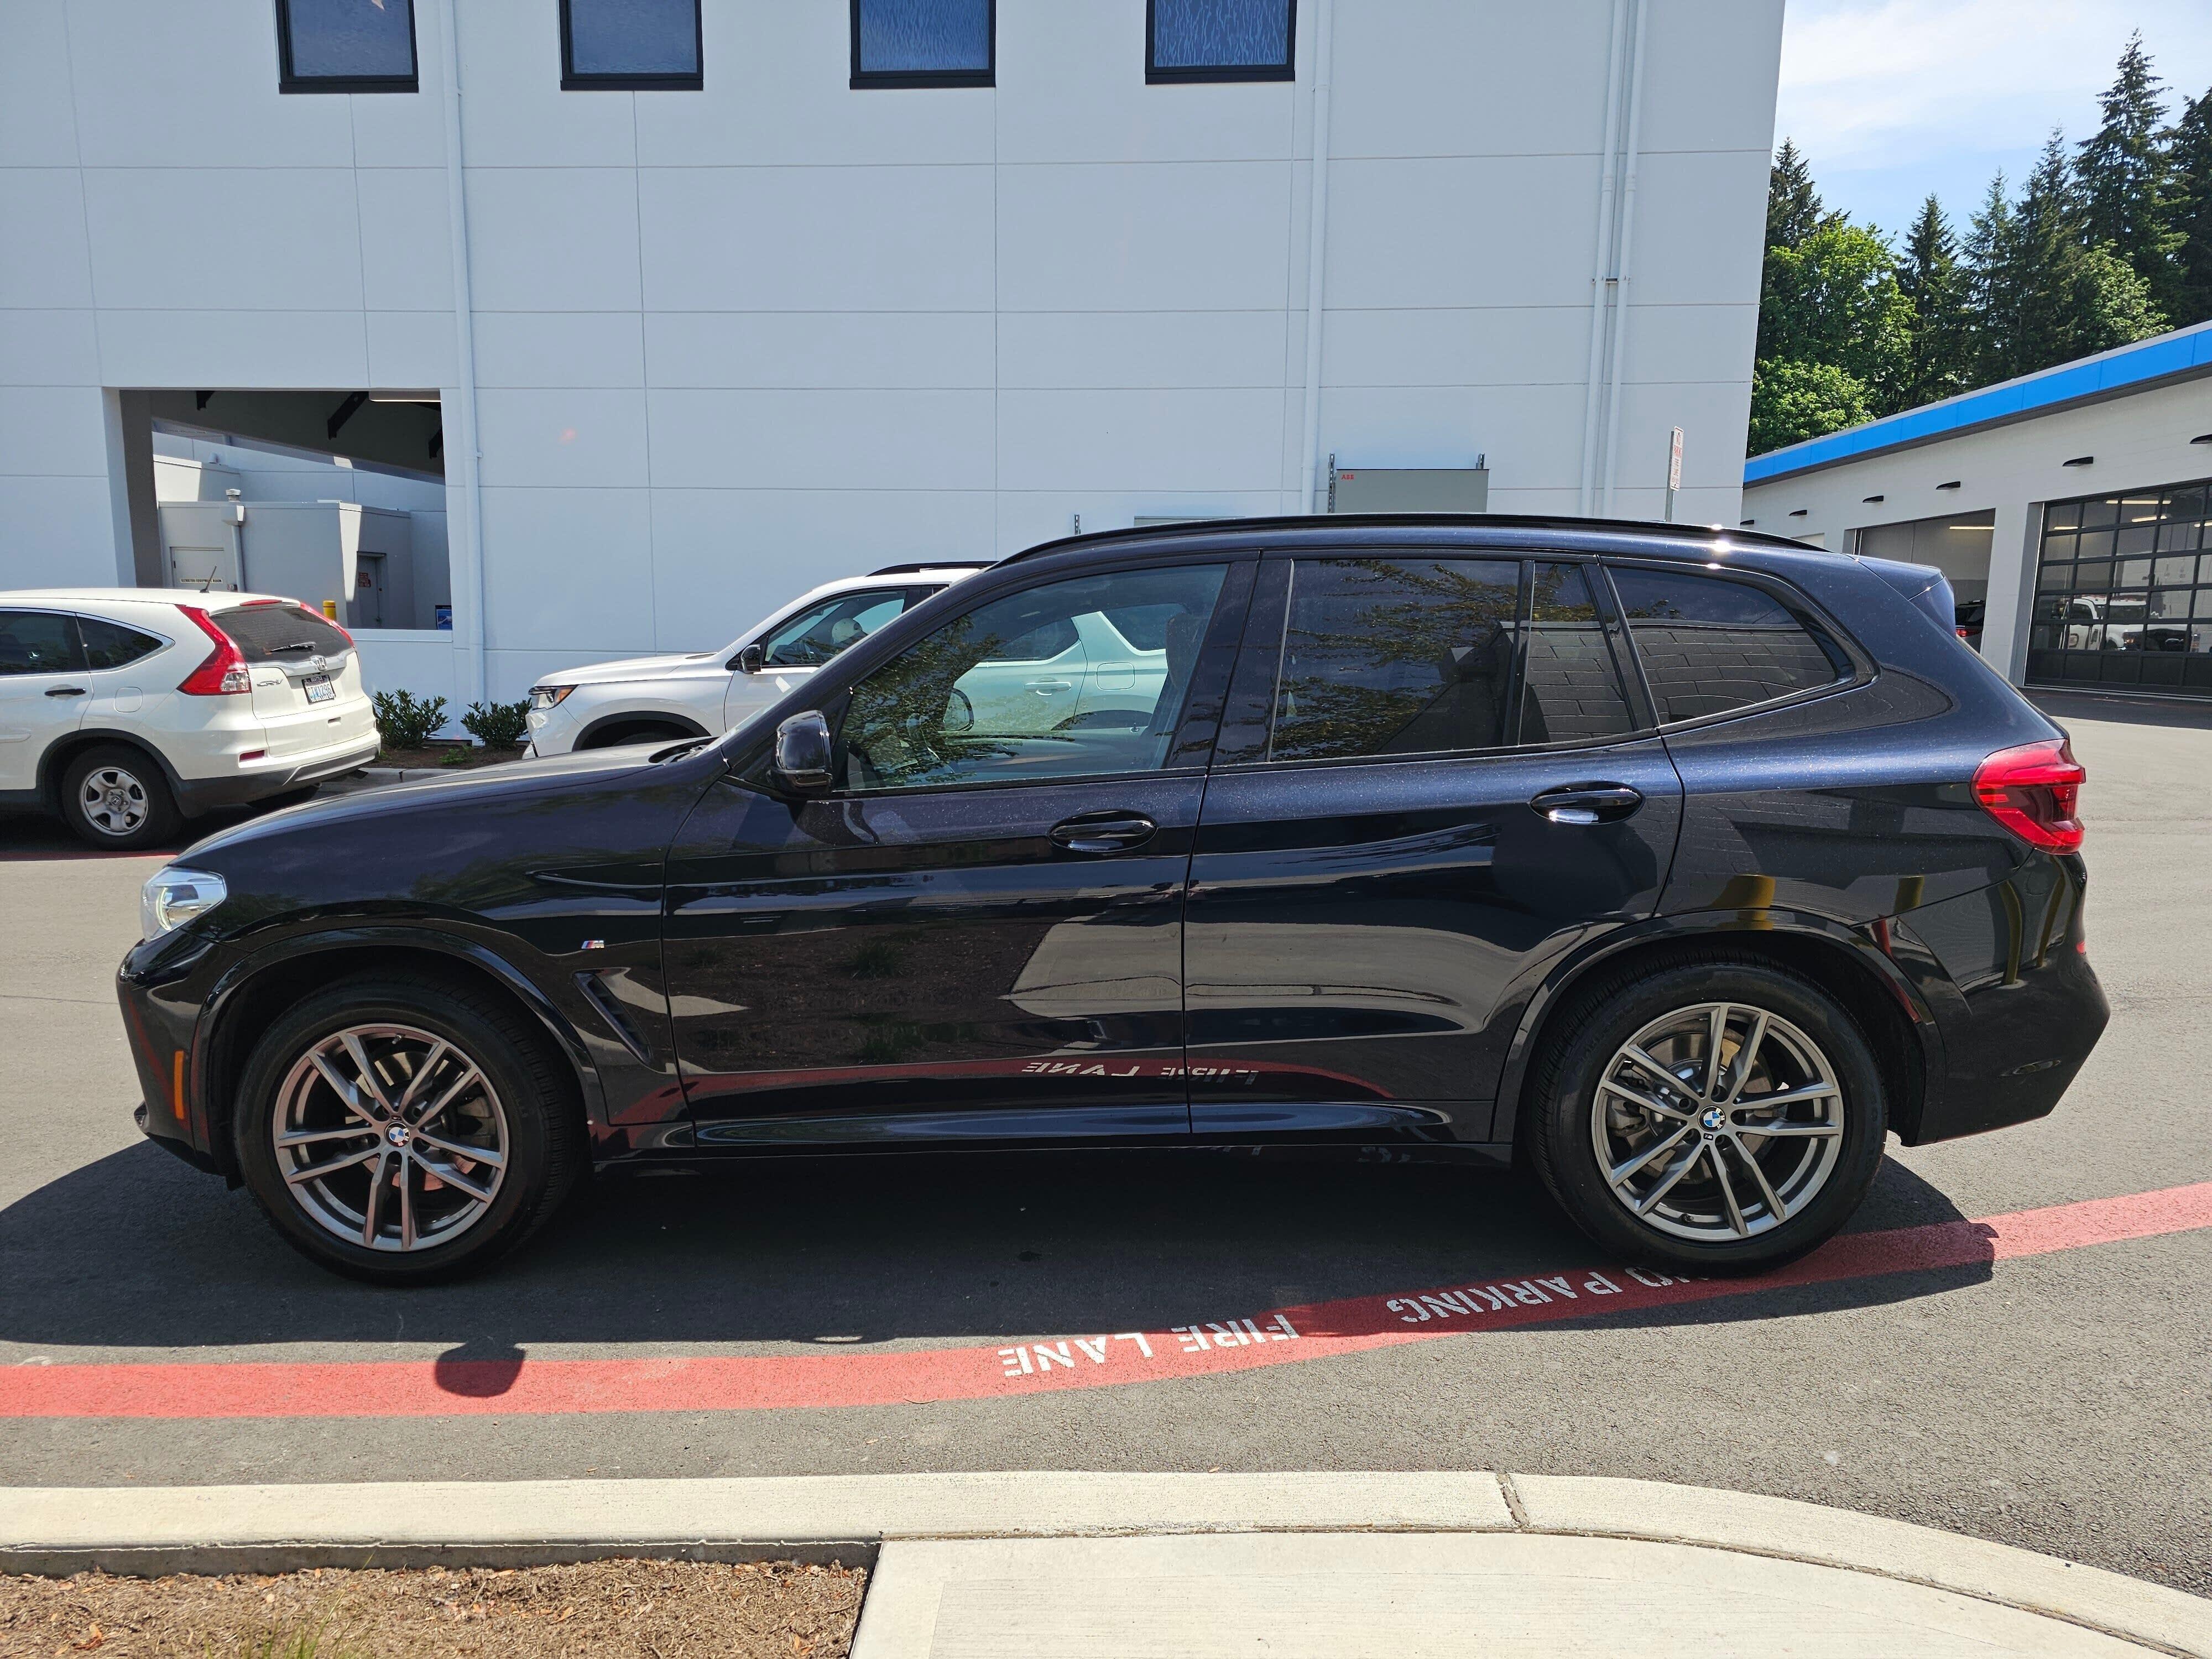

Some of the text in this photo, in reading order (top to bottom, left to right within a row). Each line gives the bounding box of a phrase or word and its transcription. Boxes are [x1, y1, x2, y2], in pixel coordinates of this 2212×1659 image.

[1386, 1271, 1623, 1322] PARKING
[998, 1332, 1154, 1377] LANE
[1171, 1314, 1300, 1353] FIRE
